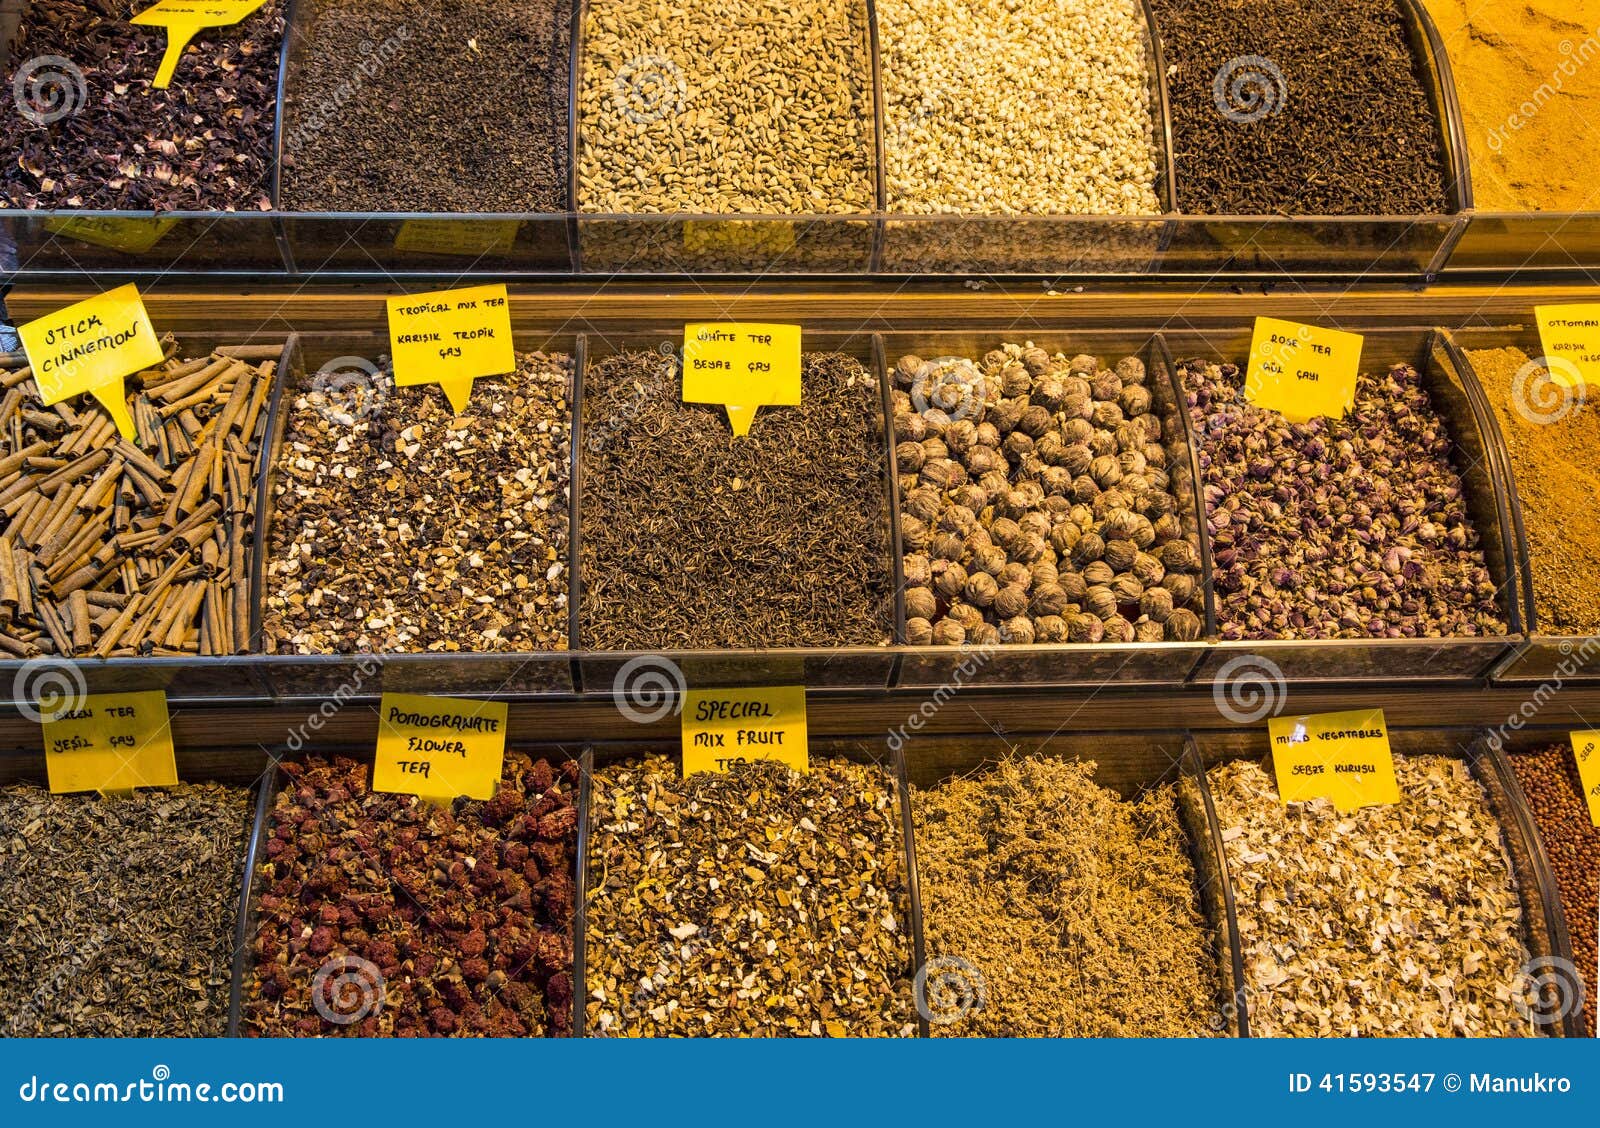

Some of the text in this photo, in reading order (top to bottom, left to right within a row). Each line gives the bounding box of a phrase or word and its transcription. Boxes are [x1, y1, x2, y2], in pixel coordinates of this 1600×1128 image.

[483, 298, 505, 307] TEA
[45, 315, 103, 345] STICK
[42, 321, 138, 373] CINNEMON
[1270, 334, 1331, 356] ROSE TEA
[693, 359, 731, 370] BEYAZ
[105, 706, 136, 718] TEA
[388, 707, 500, 733] POMOGRANATE
[695, 700, 774, 721] SPECIAL
[694, 730, 785, 747] MIX FRUIT
[1316, 729, 1384, 741] VEGATABLES
[408, 736, 466, 758] FLOWER
[1579, 742, 1596, 762] SEED
[397, 761, 430, 779] TEA
[1291, 765, 1325, 776] SEBZE
